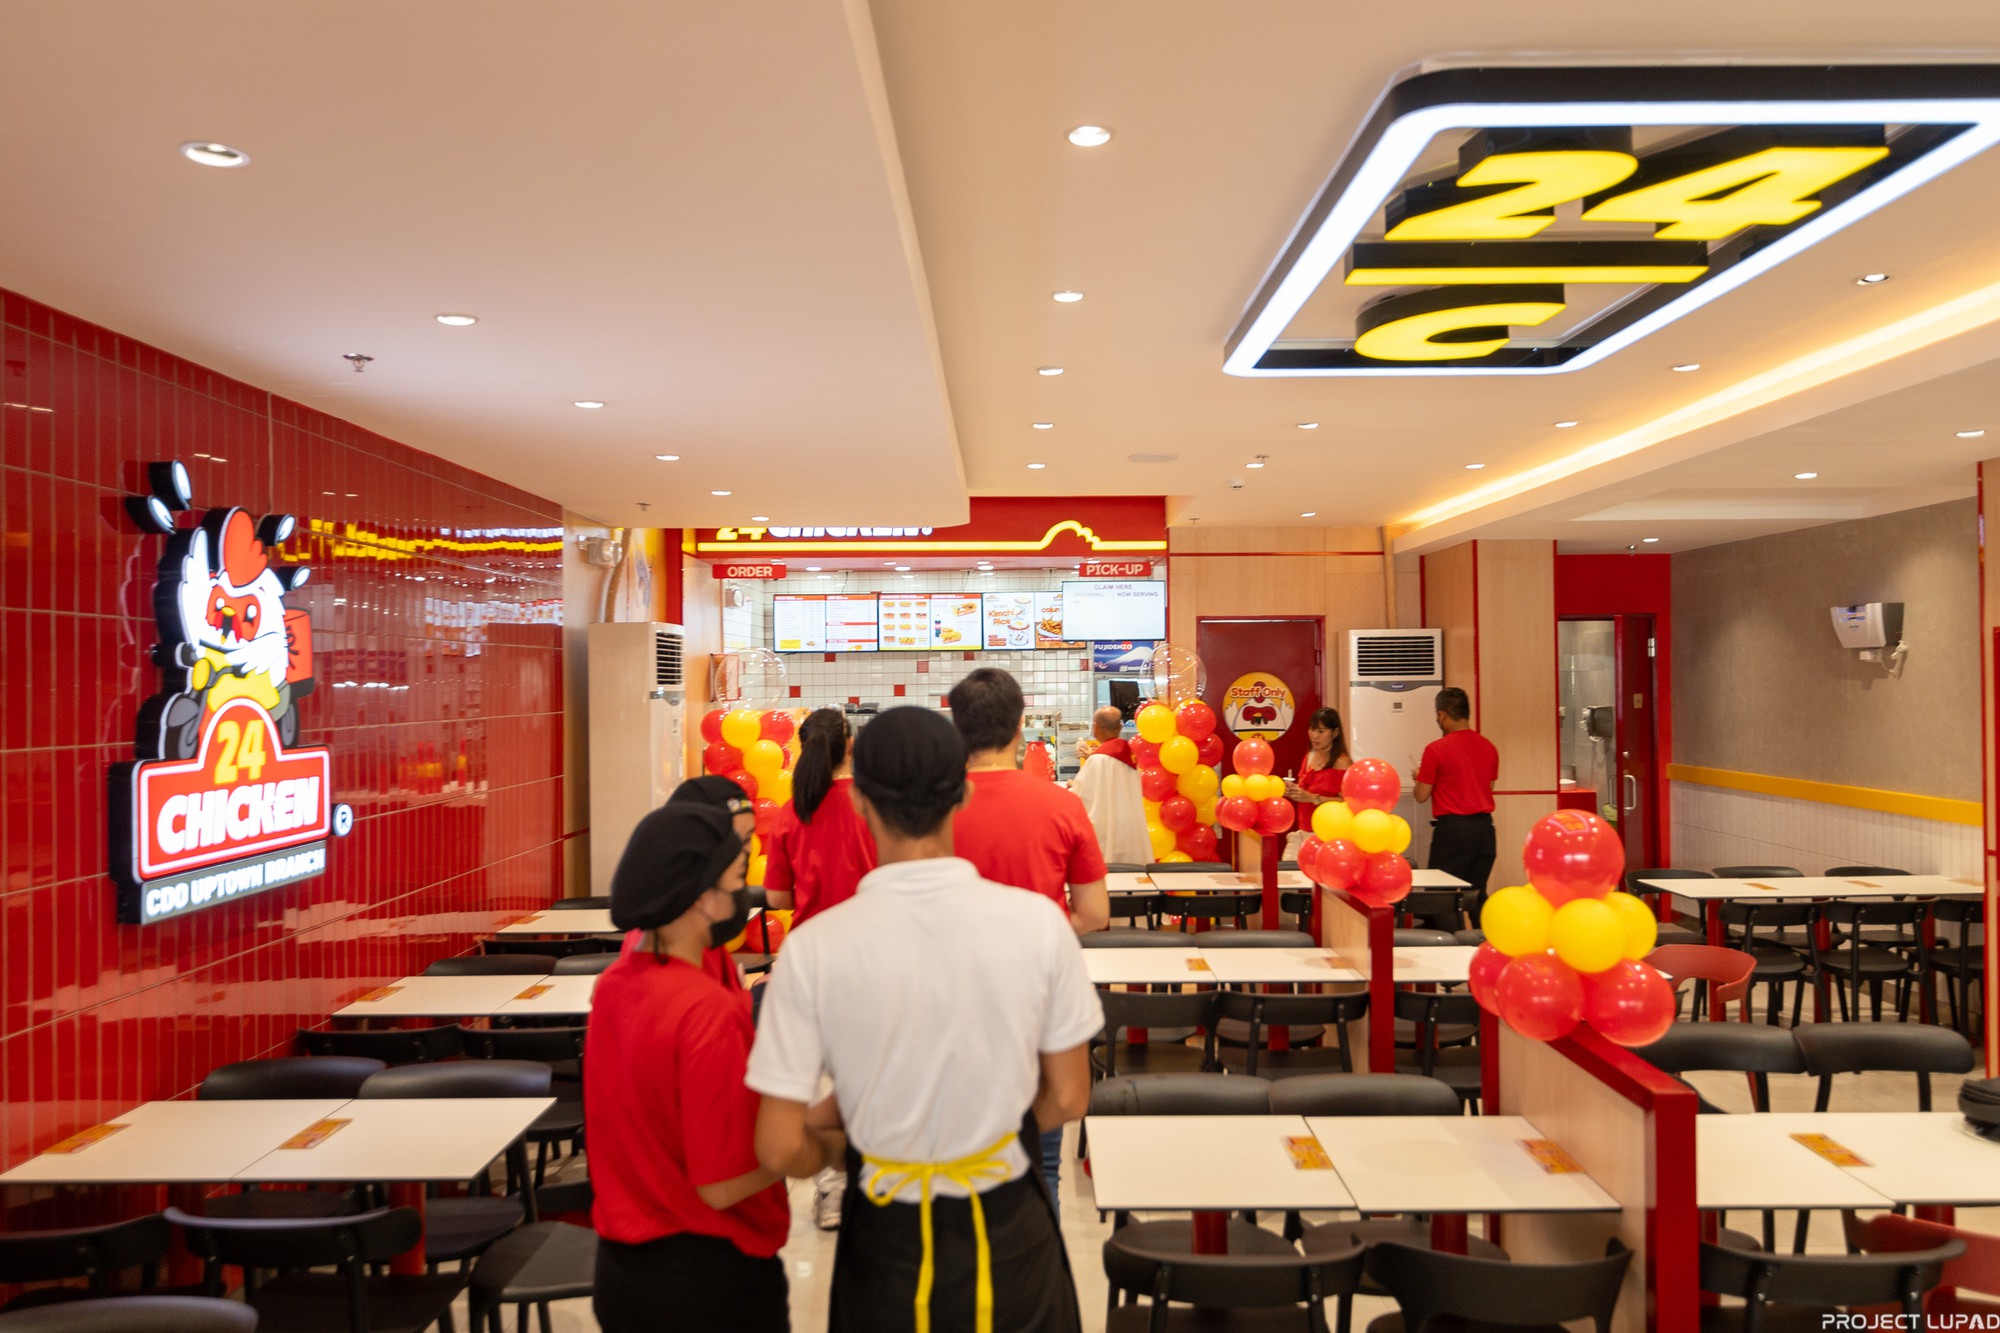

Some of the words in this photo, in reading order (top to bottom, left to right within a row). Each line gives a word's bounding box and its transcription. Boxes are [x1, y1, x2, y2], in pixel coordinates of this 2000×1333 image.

[1383, 144, 1891, 241] 24
[727, 566, 773, 577] ORDER
[1086, 564, 1144, 576] PICK-UP
[1094, 643, 1133, 651] FUJIDENZO
[1231, 687, 1261, 697] Staff
[1262, 687, 1286, 698] Only
[214, 719, 266, 785] 24
[156, 776, 320, 855] CHICKEN
[146, 882, 190, 917] CDO
[190, 863, 264, 905] UPTOWN
[264, 848, 326, 885] BRANCH
